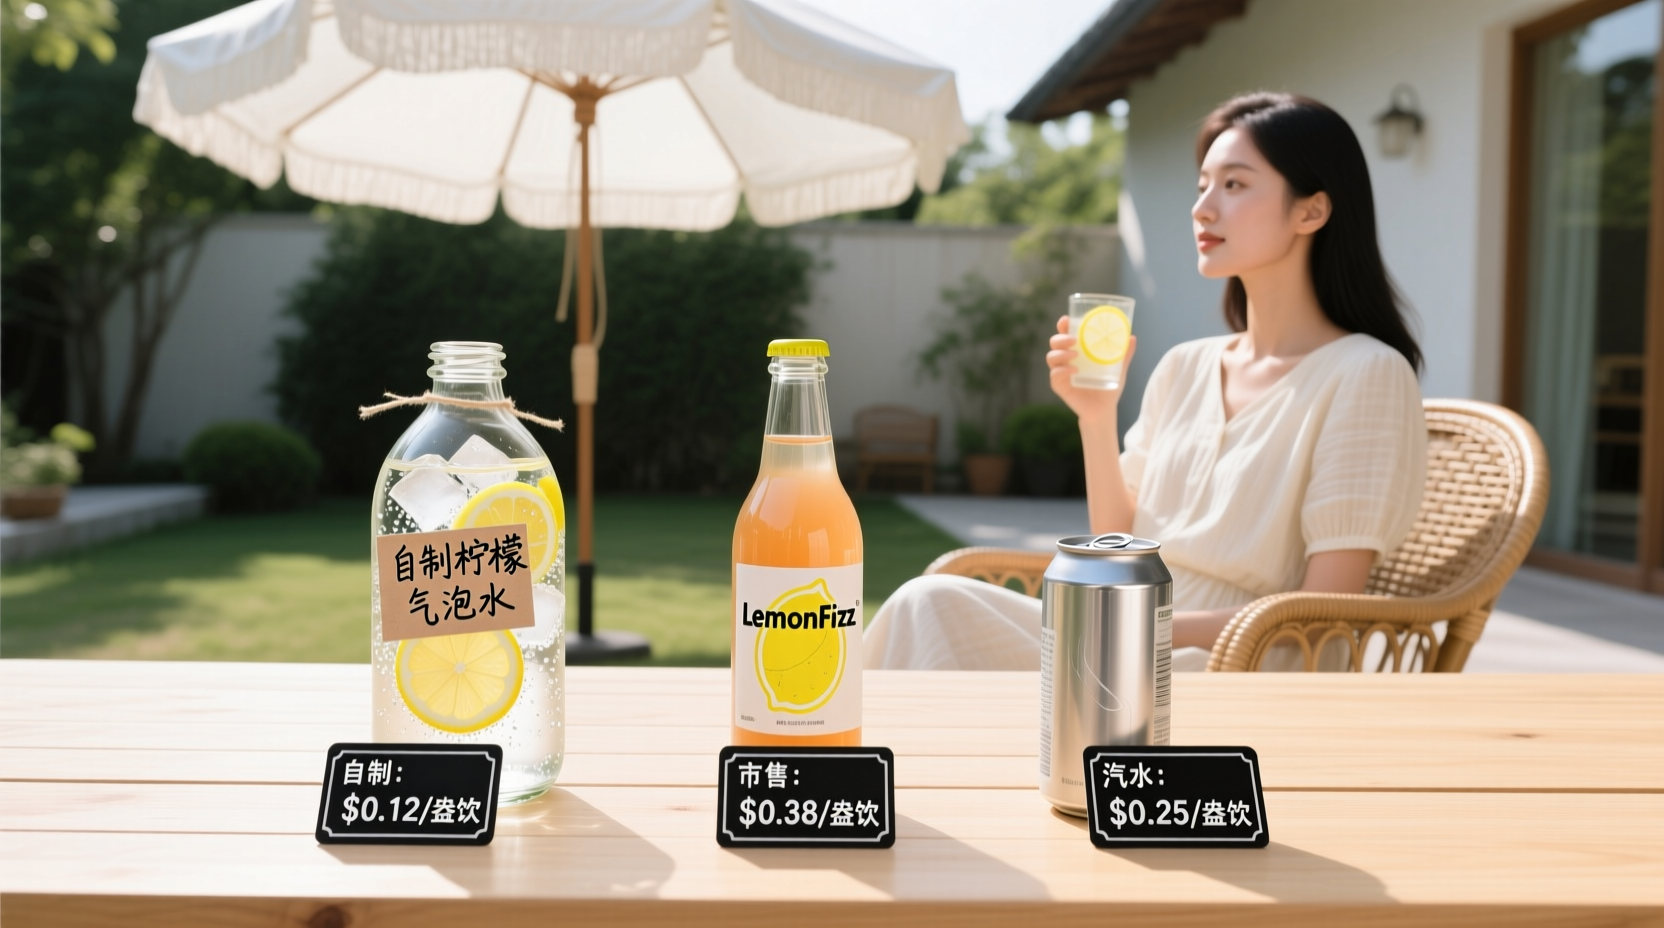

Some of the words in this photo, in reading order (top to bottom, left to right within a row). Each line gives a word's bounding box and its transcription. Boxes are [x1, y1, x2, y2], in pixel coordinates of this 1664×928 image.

[394, 532, 528, 582] 自制柠檬
[408, 582, 516, 626] 气泡水
[742, 602, 857, 630] LemonFizz
[343, 758, 403, 786] 自制：
[738, 761, 800, 789] 市售：
[1102, 762, 1165, 789] 汽水：
[341, 791, 482, 826] $0.12/盎饮
[739, 795, 880, 830] $0.38/盎饮
[1109, 795, 1253, 830] $0.25/盎饮
